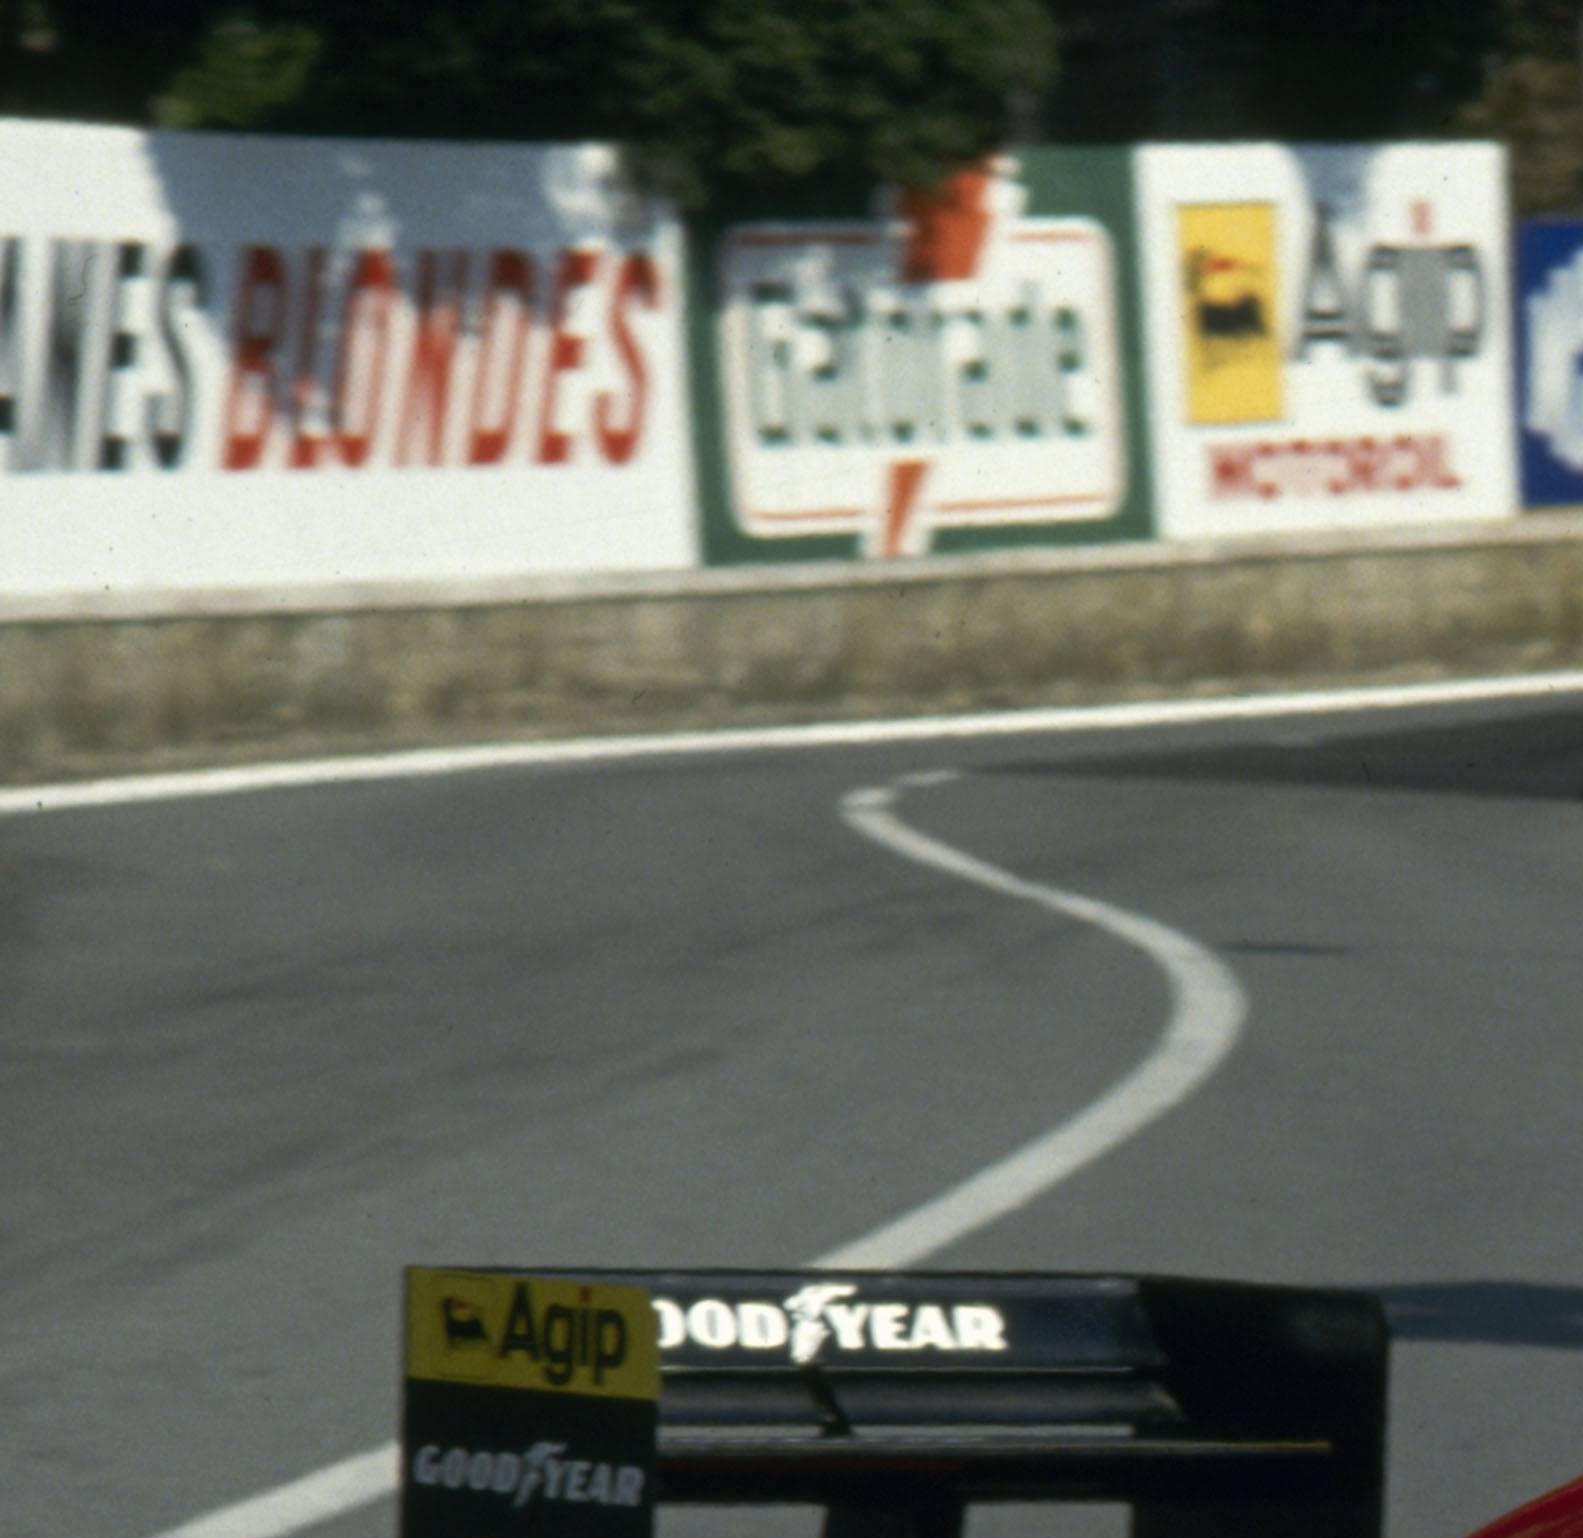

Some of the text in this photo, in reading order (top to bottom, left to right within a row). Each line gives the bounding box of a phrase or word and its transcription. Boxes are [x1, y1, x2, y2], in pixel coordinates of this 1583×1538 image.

[222, 240, 662, 470] BLONDES
[1290, 198, 1485, 408] Agip
[497, 1279, 629, 1386] Agip
[650, 1288, 1009, 1360] OODYEAR
[413, 1443, 645, 1506] GOODYEAR
